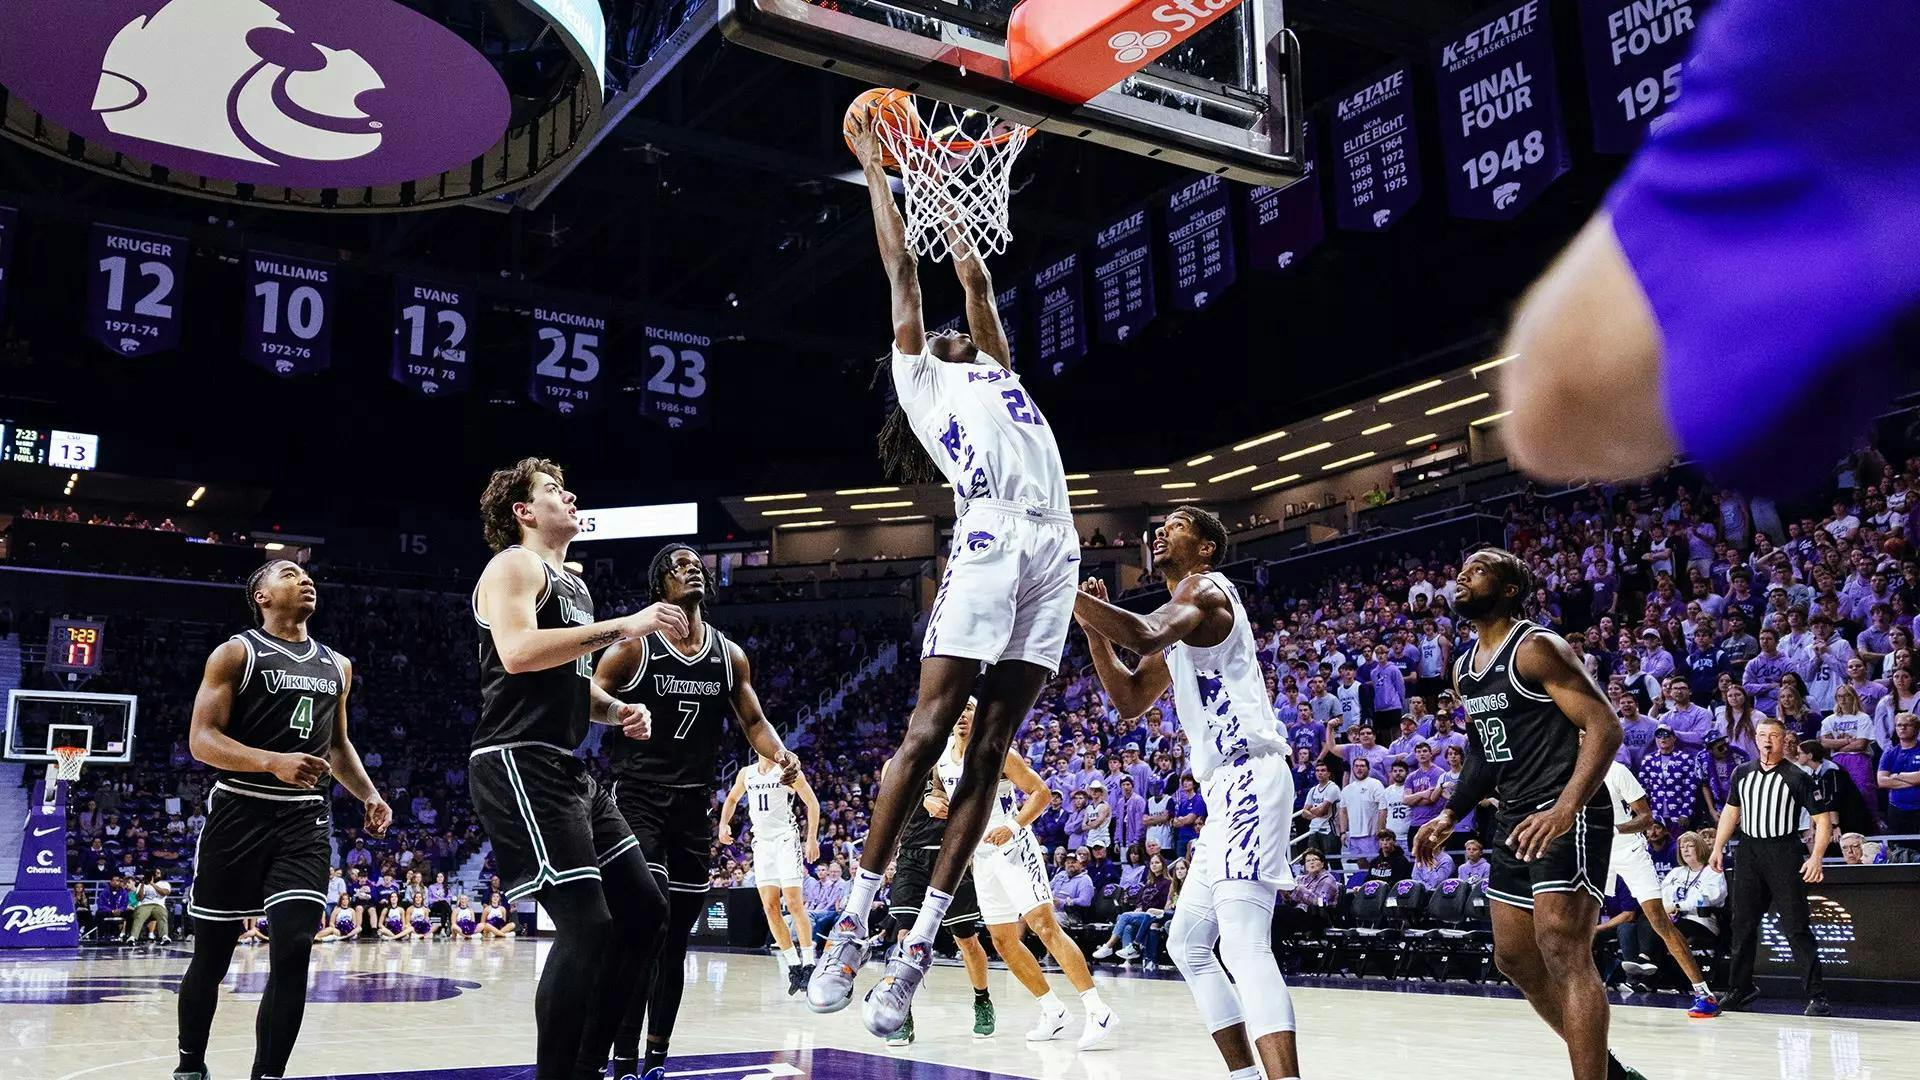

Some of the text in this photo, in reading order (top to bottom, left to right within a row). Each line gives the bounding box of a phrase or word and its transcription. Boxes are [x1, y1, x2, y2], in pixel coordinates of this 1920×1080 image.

[1441, 0, 1538, 68] K-STATE
[1611, 5, 1696, 66] FOUR
[1450, 24, 1534, 73] MEN'S BASKETBALL
[1338, 70, 1404, 118] K-STATE
[1459, 61, 1532, 113] FINAL
[1617, 62, 1684, 122] 195
[1361, 89, 1400, 113] BASKETBALL
[1461, 85, 1533, 138] FOUR
[1343, 114, 1405, 154] ELITE EIGHT
[1363, 116, 1382, 131] NCAA
[1380, 135, 1403, 154] 1964
[1349, 151, 1370, 168] 1951
[1381, 149, 1405, 167] 1972
[1462, 129, 1545, 190] 1948
[1350, 164, 1372, 181] 1958
[1383, 162, 1406, 180] 1973
[1170, 174, 1222, 209] K-STATE
[1352, 177, 1374, 194] 1959
[1384, 175, 1408, 193] 1975
[1259, 197, 1278, 214] 2018
[1353, 190, 1374, 208] 1961
[1097, 210, 1144, 246] K-STATE
[1168, 206, 1226, 243] SWEET SIXTEEN
[1259, 209, 1279, 225] 2023
[107, 235, 172, 257] KRUGER
[255, 260, 328, 282] WILLIAMS
[1035, 253, 1076, 286] K-STATE
[1095, 245, 1148, 278] SWEET SIXTEEN
[100, 256, 175, 319] 12
[413, 286, 459, 305] EVANS
[1044, 286, 1067, 305] NCAA
[255, 280, 324, 339] 10
[534, 308, 604, 331] BLACKMAN
[104, 320, 159, 337] 1971-74
[403, 305, 466, 363] 12
[645, 326, 711, 347] RICHMOND
[261, 342, 311, 359] 1972-76
[536, 327, 600, 383] 25
[647, 344, 707, 398] 23
[545, 385, 589, 400] 1977-81
[655, 401, 697, 416] 1986-88
[15, 428, 38, 441] 7:23
[61, 445, 86, 461] 13
[400, 534, 428, 554] 15
[67, 627, 96, 643] 7:23
[68, 643, 90, 665] 17
[261, 670, 337, 695] VIKINGS
[653, 674, 721, 696] VIKINGS
[290, 696, 314, 739] 4
[674, 701, 700, 739] 7
[748, 782, 783, 790] K-STATE
[758, 793, 769, 811] 11
[1392, 807, 1407, 819] 25
[26, 866, 62, 874] Channel
[2, 905, 75, 931] Dillons
